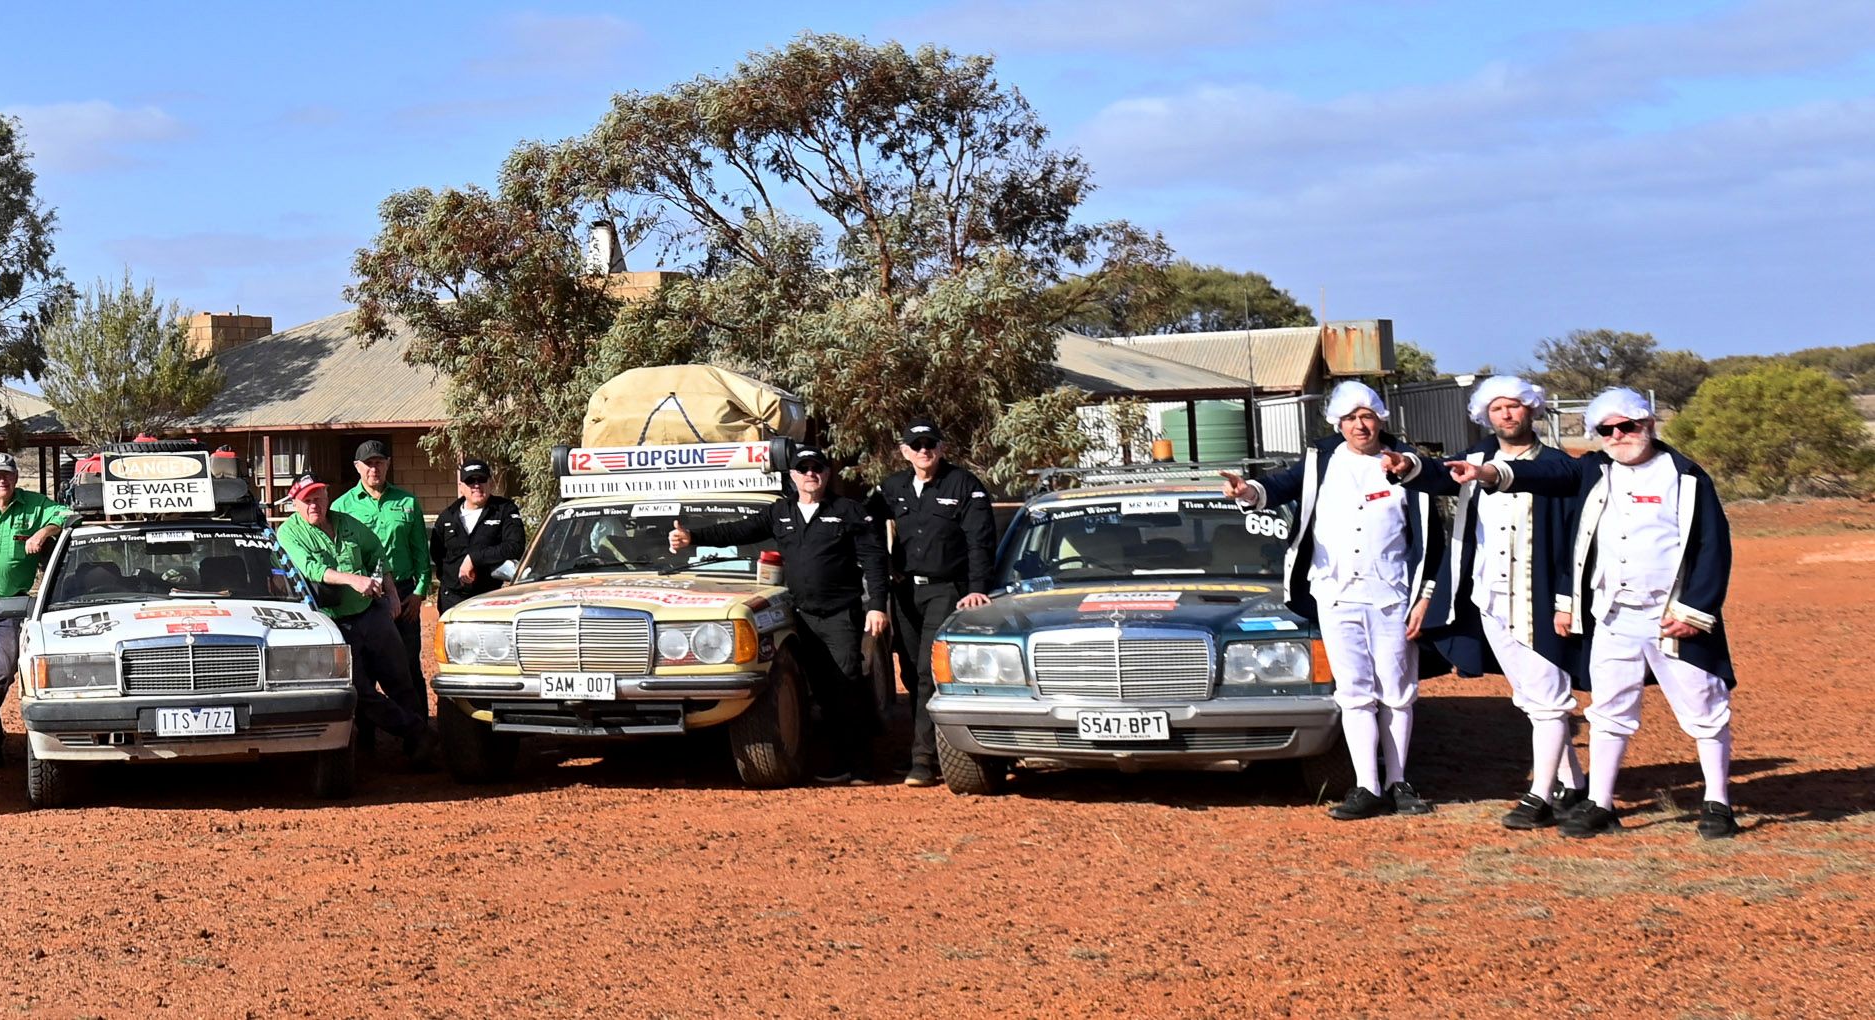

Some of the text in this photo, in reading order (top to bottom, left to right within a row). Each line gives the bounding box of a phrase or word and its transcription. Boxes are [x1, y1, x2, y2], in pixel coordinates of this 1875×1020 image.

[570, 453, 591, 471] 12
[627, 448, 705, 467] TOPGUN
[117, 462, 194, 474] DANGER
[117, 482, 199, 495] BEWARE
[683, 479, 710, 490] NEED
[714, 478, 735, 489] FOR
[113, 497, 193, 510] OF RAM
[683, 505, 702, 513] Tim
[704, 505, 736, 513] Adams
[1183, 501, 1204, 509] Tim
[1206, 502, 1240, 510] Adam
[603, 508, 628, 516] Wines
[1051, 510, 1085, 520] Adams
[1086, 506, 1117, 515] Wines
[1245, 513, 1289, 540] 696
[71, 534, 145, 547] Tim Adams Wines
[235, 538, 273, 549] RAM
